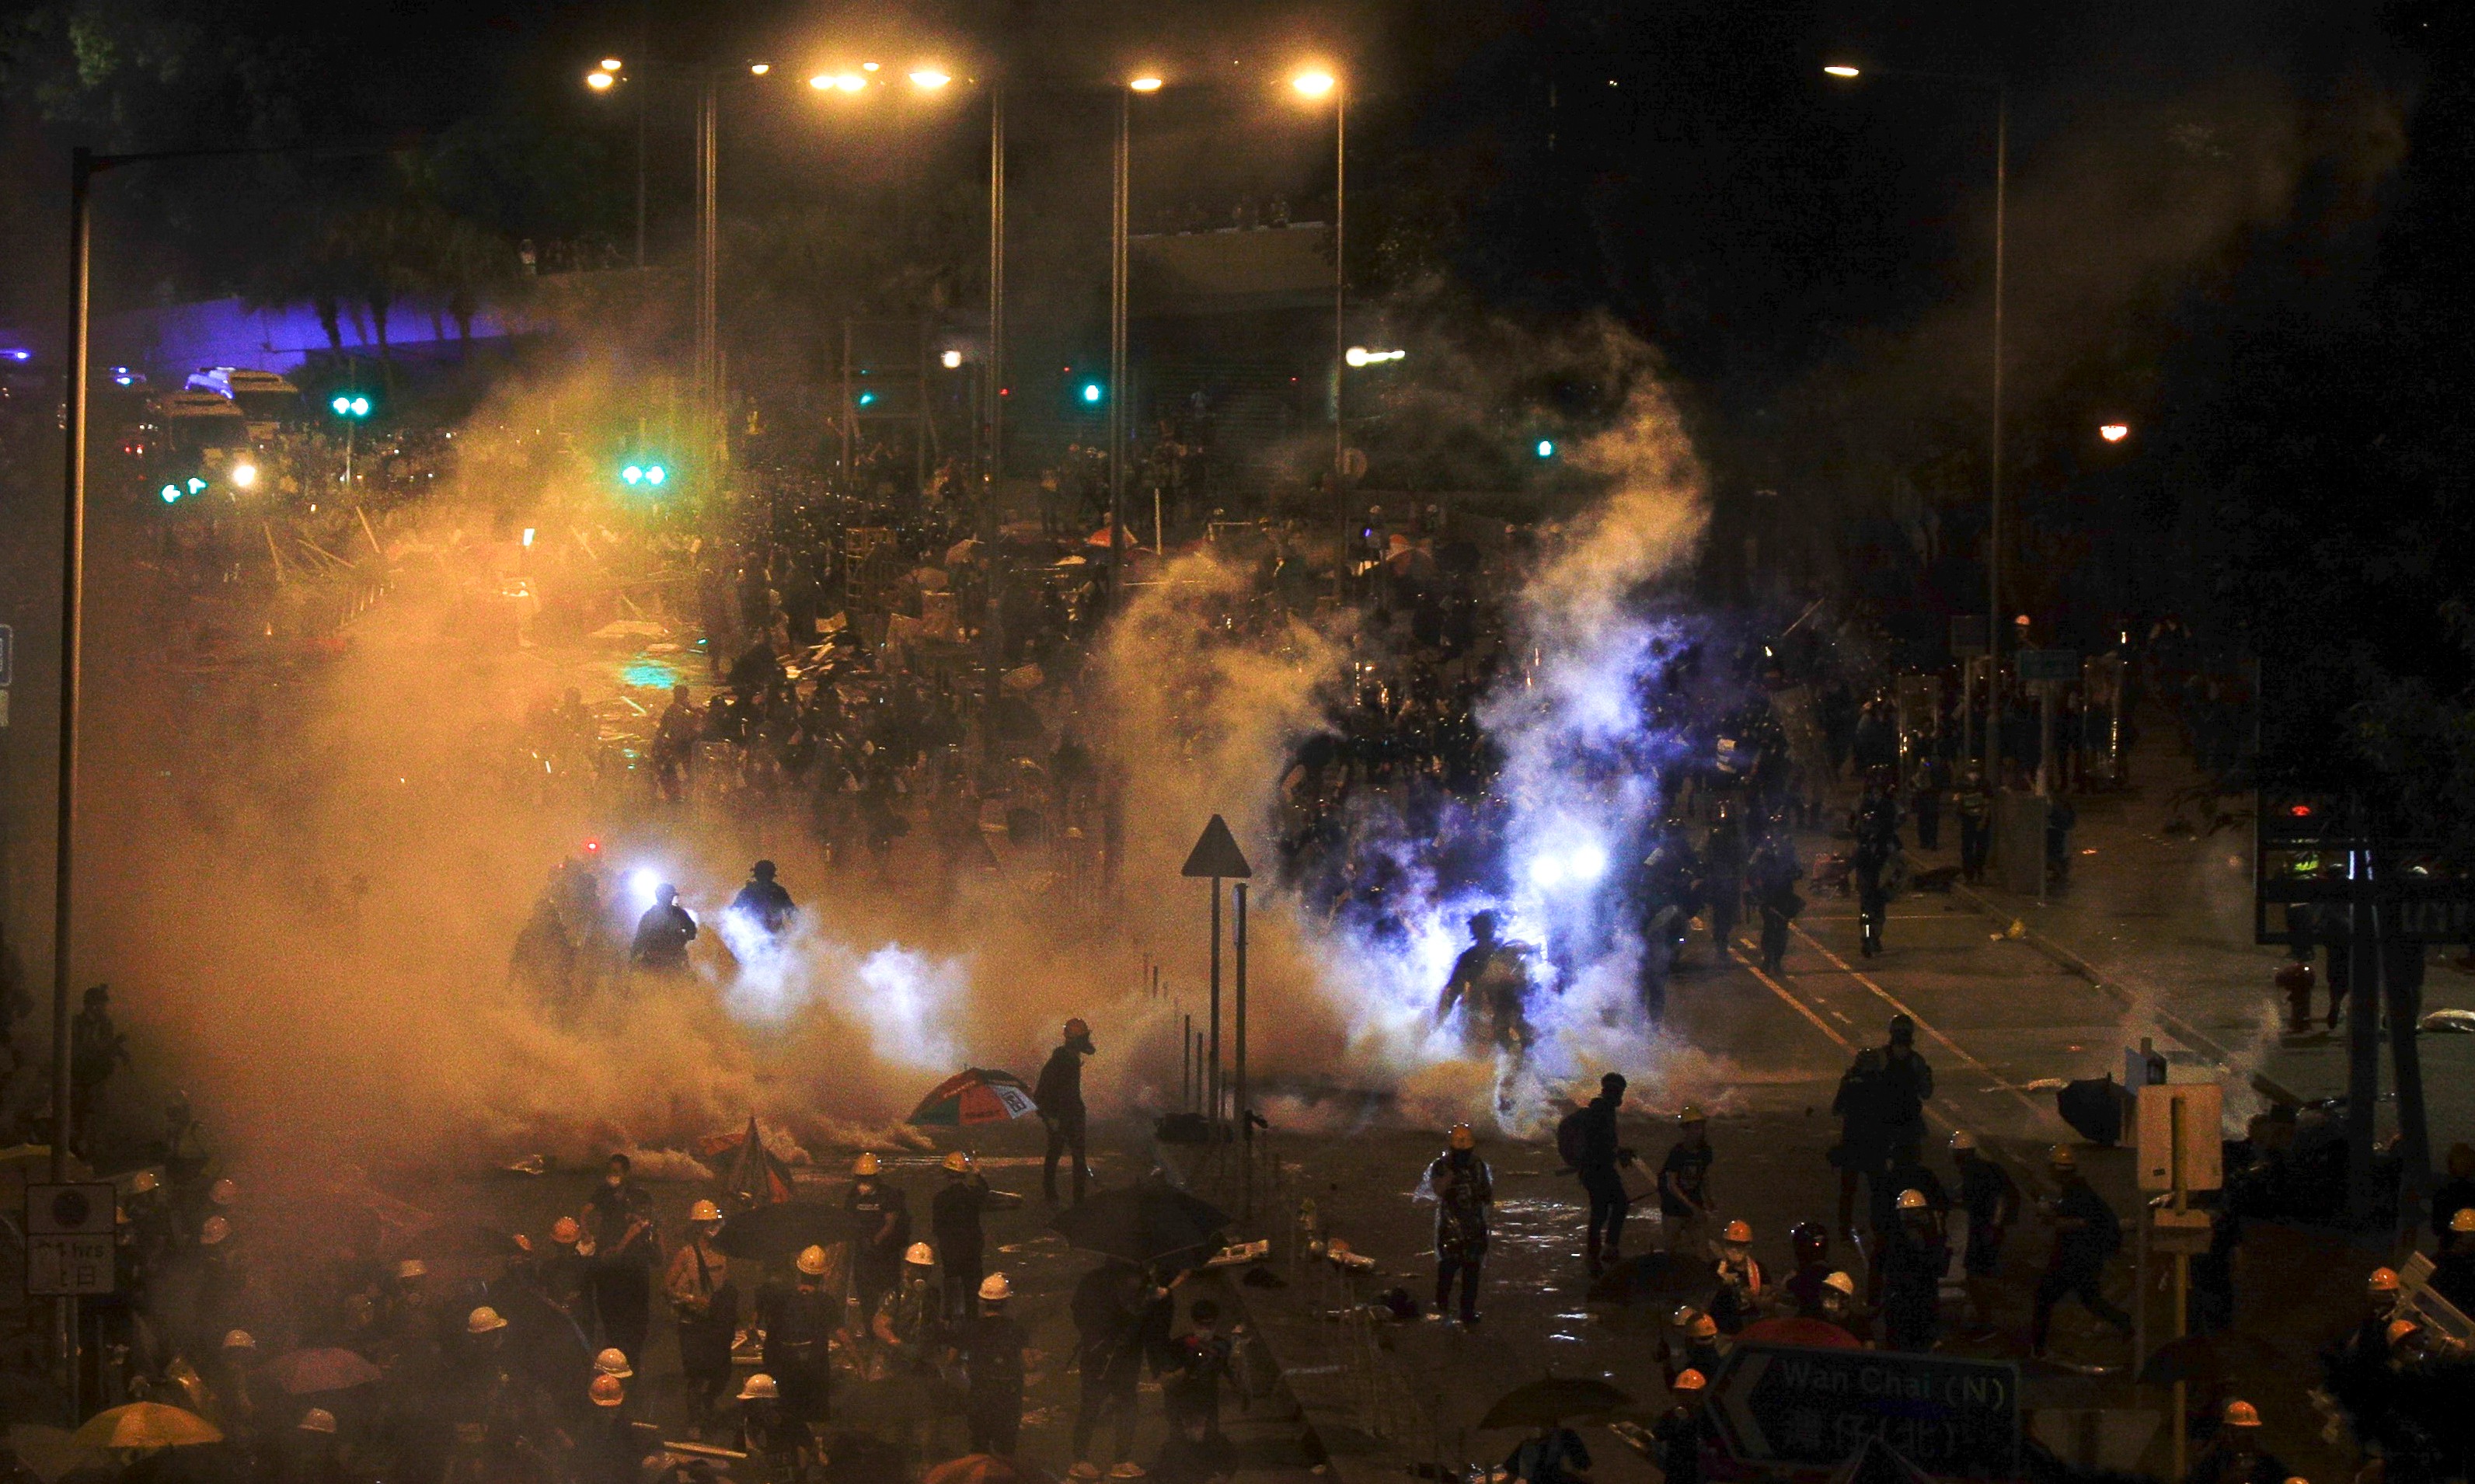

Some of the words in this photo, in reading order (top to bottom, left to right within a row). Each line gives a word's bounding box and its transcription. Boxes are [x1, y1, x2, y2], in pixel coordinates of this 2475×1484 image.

[71, 1242, 104, 1258] hrs
[1781, 1359, 1849, 1391] Wan
[1860, 1365, 1931, 1399] Chai
[1944, 1374, 2004, 1411] (N)
